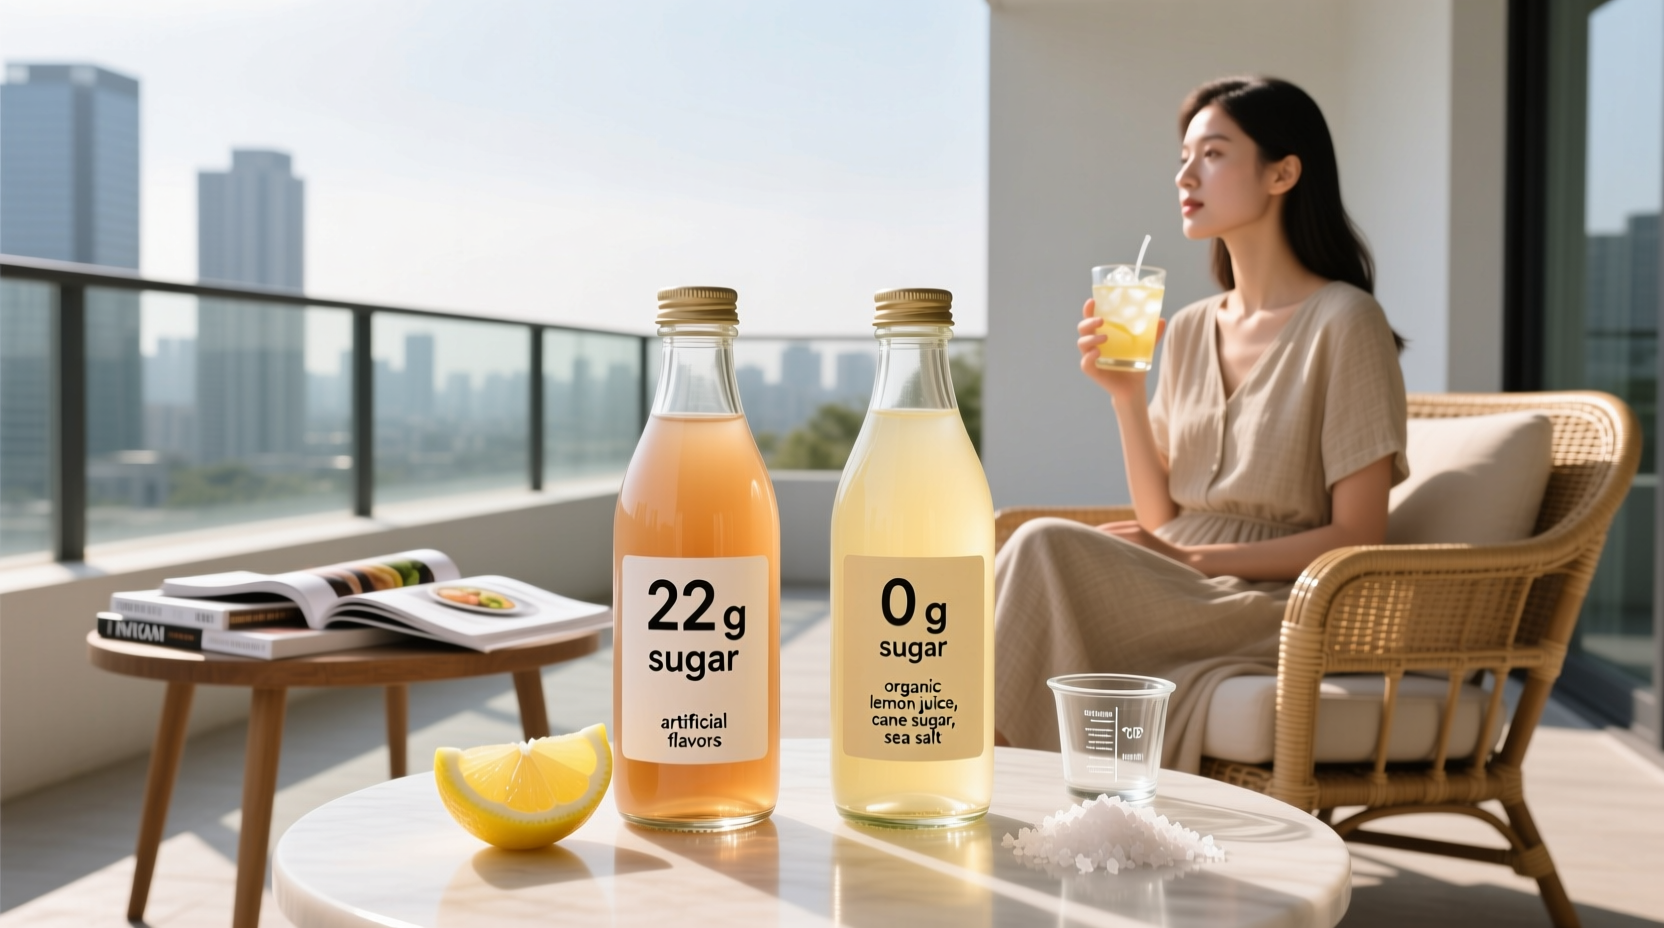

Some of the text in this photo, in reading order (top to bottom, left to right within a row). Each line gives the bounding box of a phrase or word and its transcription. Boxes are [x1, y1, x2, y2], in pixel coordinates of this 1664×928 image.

[880, 641, 947, 663] sugar
[649, 650, 739, 681] sugar
[884, 679, 941, 696] organic
[870, 695, 957, 714] lemon juice,
[661, 713, 726, 729] artificial
[872, 715, 955, 731] cane sugar,
[668, 732, 722, 747] flavors
[884, 730, 942, 744] sea salt
